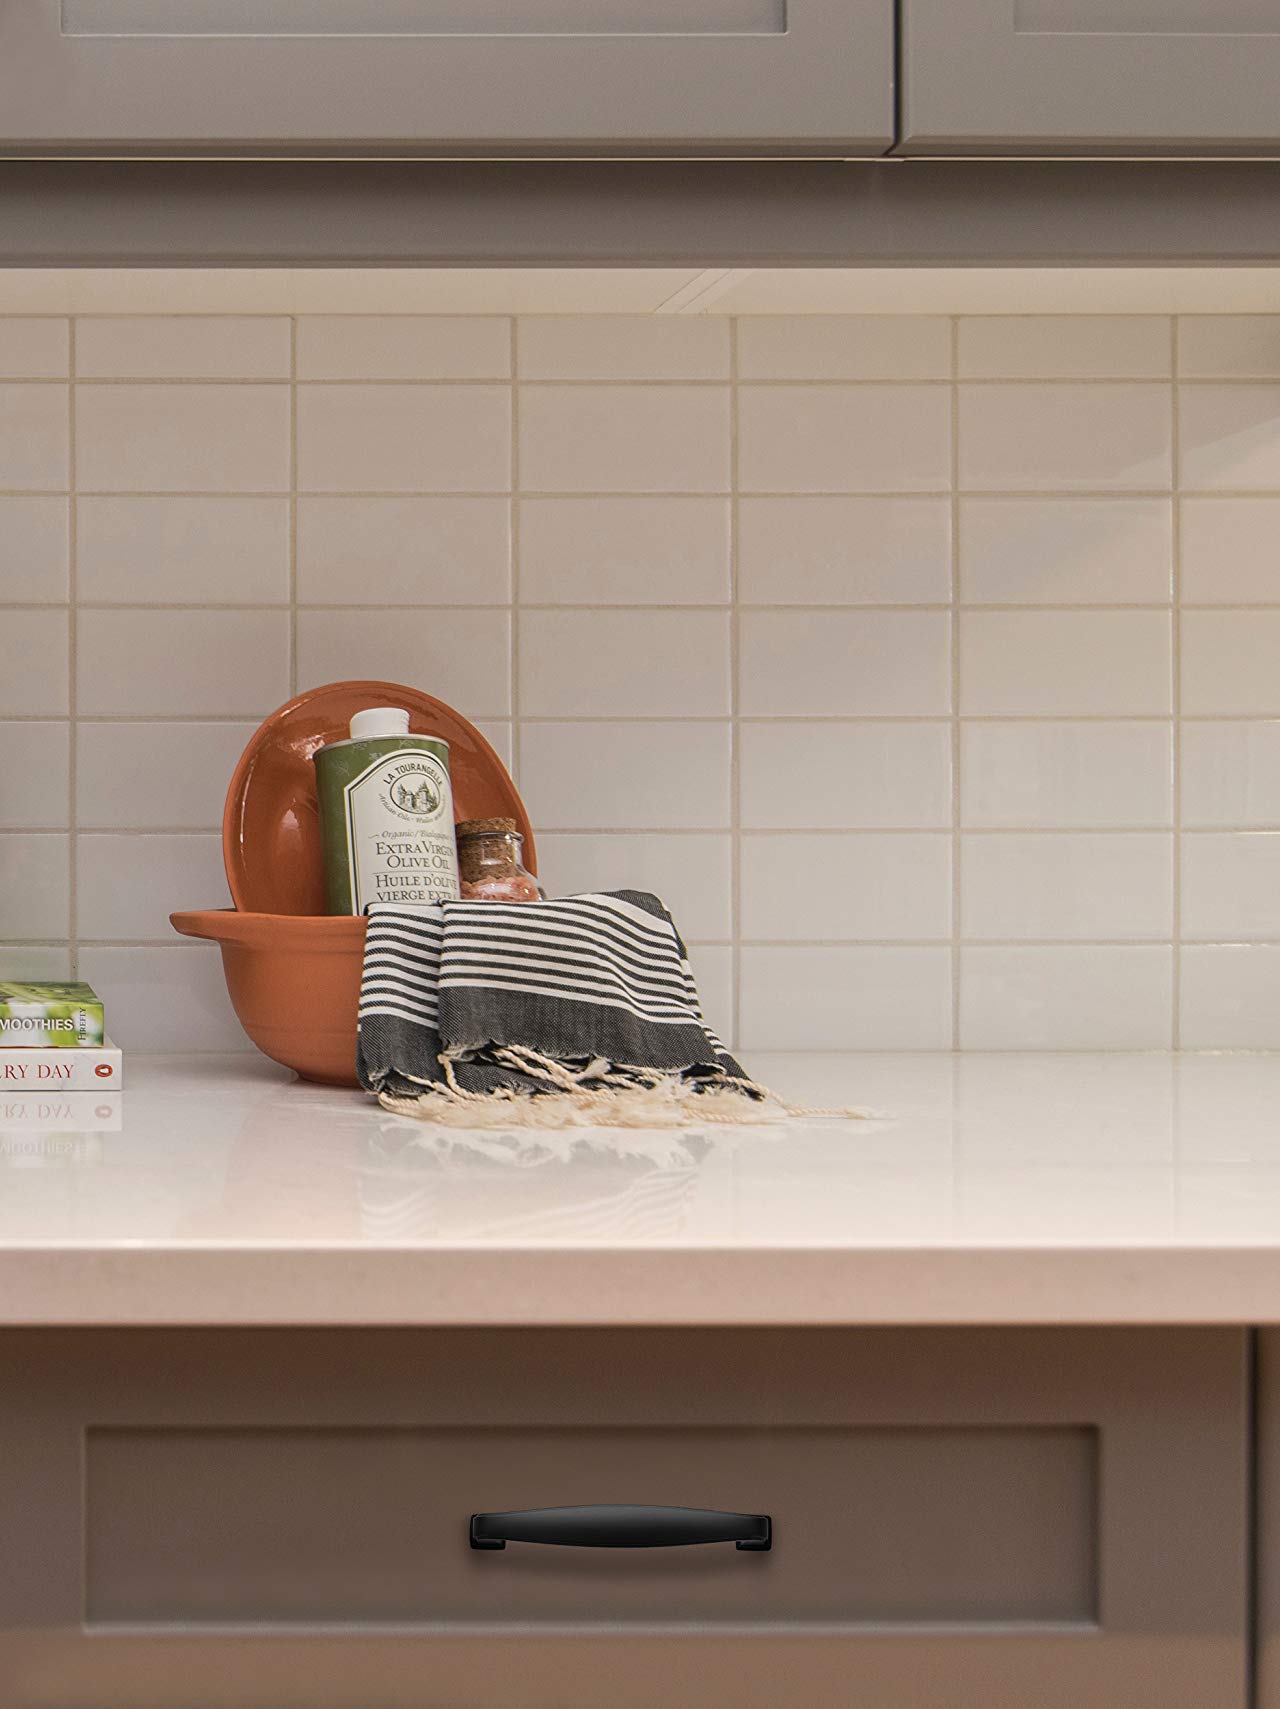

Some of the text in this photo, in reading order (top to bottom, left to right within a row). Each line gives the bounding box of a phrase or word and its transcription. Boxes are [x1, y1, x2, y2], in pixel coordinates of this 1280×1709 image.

[383, 773, 396, 785] LA
[376, 841, 422, 855] EXTRA
[387, 855, 450, 870] OLIVE OIL
[376, 874, 421, 888] HUILE
[376, 890, 426, 901] VIERGE
[38, 1064, 75, 1080] DAY
